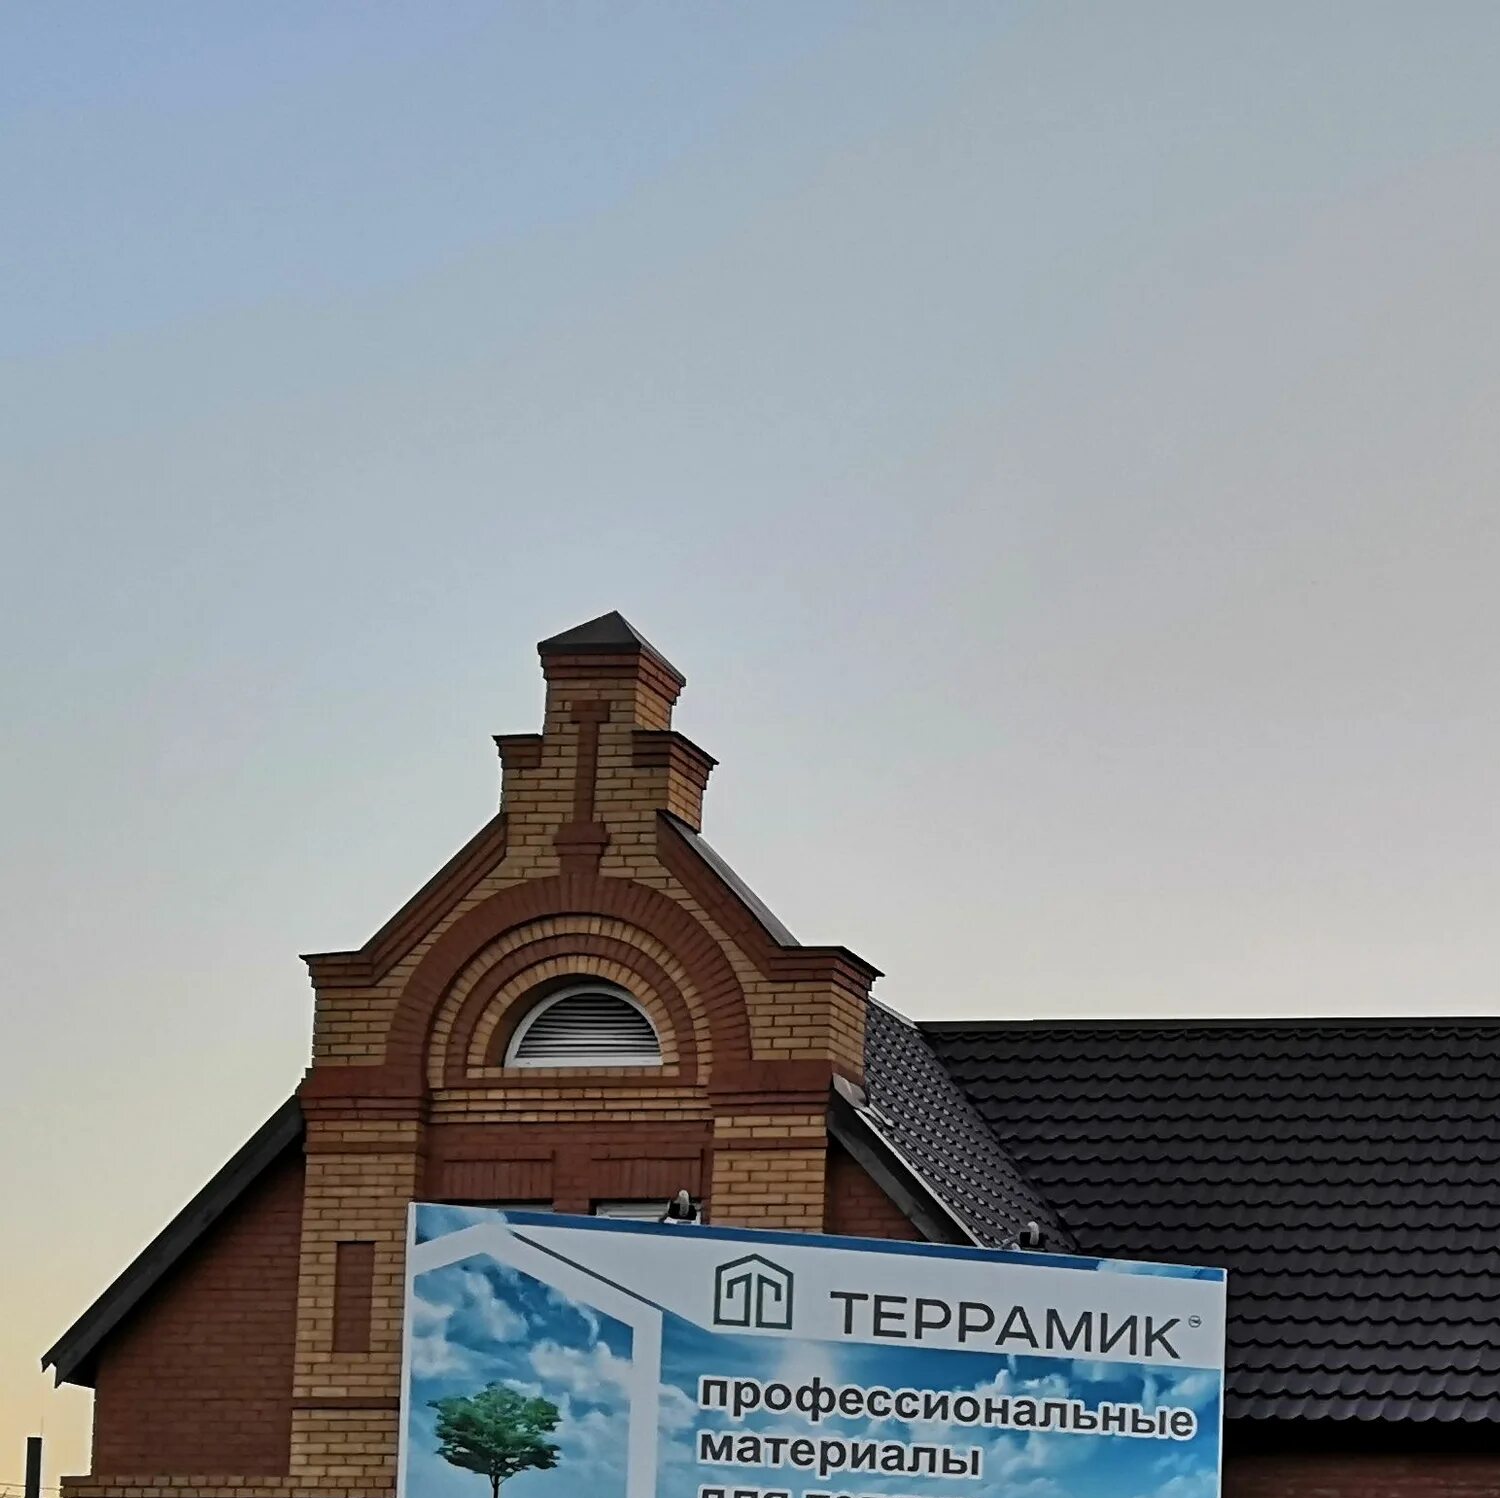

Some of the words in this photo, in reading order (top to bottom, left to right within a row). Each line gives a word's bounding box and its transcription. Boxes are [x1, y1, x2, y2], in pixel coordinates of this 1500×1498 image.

[829, 1290, 1181, 1359] ТЕРРАМИК
[699, 1376, 1195, 1439] профессиональные
[699, 1432, 981, 1479] материалы
